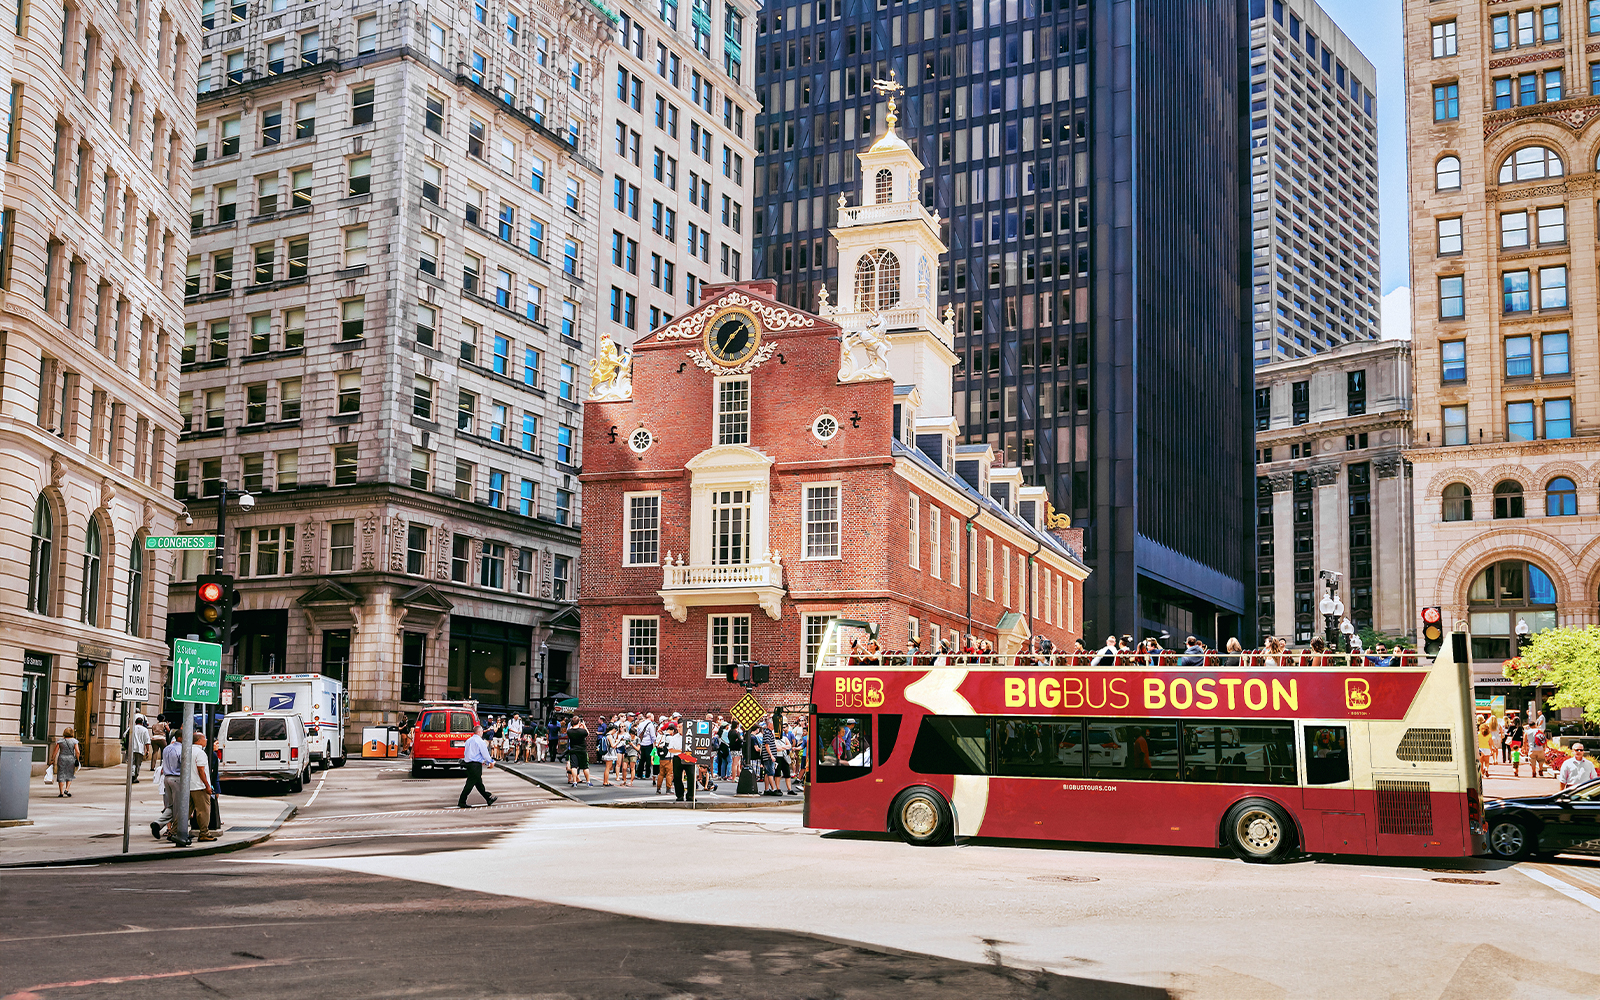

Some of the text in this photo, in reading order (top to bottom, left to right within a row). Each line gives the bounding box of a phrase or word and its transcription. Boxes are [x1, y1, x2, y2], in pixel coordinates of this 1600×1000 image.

[158, 537, 204, 547] CONGRESS
[181, 645, 197, 655] Station
[197, 657, 218, 667] Downtown
[132, 664, 142, 673] NO
[196, 666, 216, 677] Crossing
[129, 675, 145, 685] TURN
[197, 679, 217, 688] Government
[835, 677, 863, 693] BIG
[124, 686, 148, 697] ON RED
[196, 687, 210, 697] Center
[1144, 678, 1298, 711] BOSTON
[835, 693, 863, 708] BUS
[699, 722, 708, 733] P
[695, 738, 710, 747] 7.00
[1062, 783, 1117, 792] BIGBUSTOURS.COM
